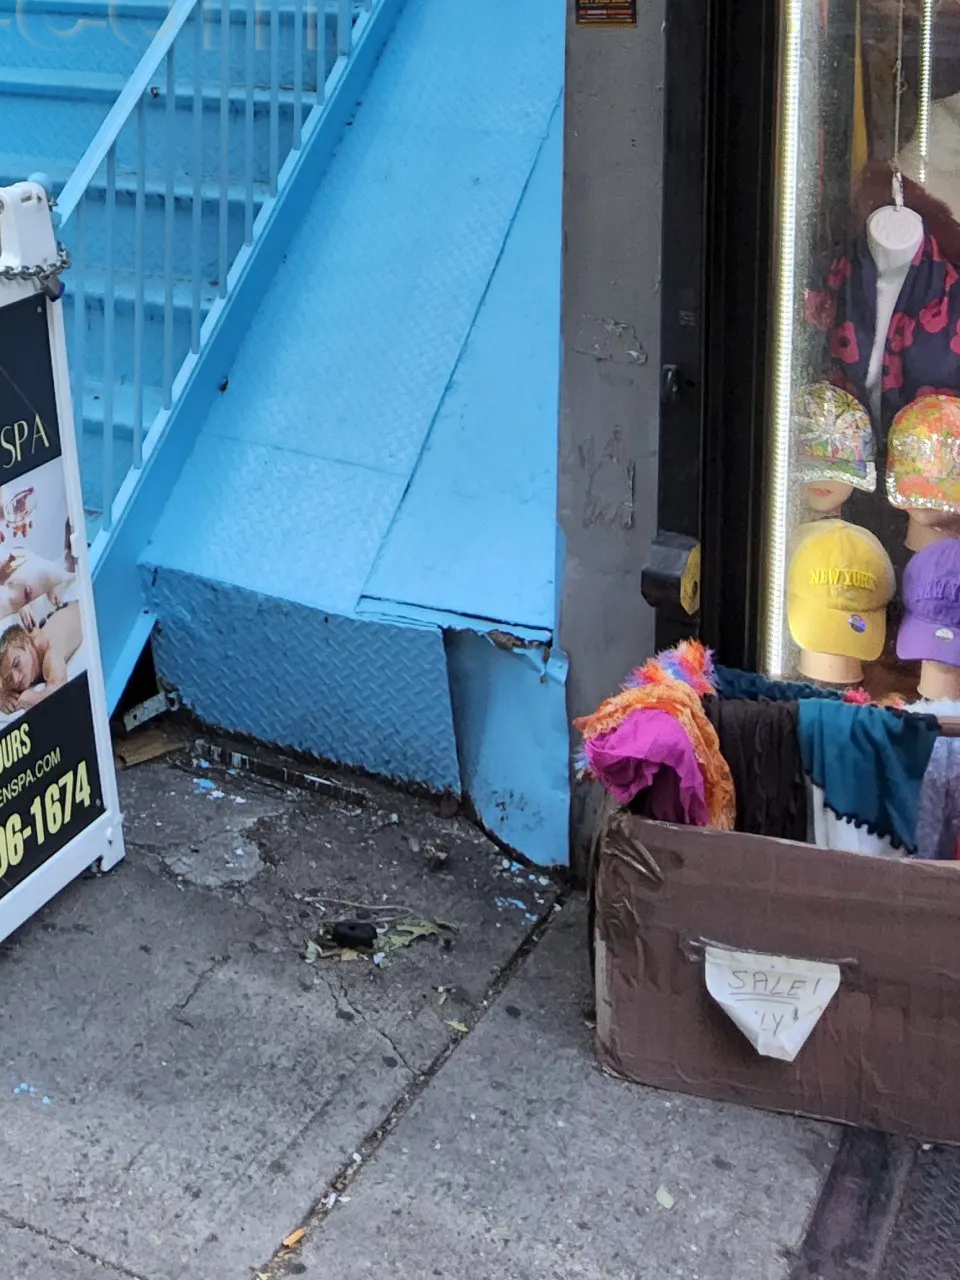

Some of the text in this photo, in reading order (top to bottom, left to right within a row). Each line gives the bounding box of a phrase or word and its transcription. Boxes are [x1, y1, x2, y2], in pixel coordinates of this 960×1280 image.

[0, 413, 50, 469] SPA
[809, 568, 878, 591] NEW YORK
